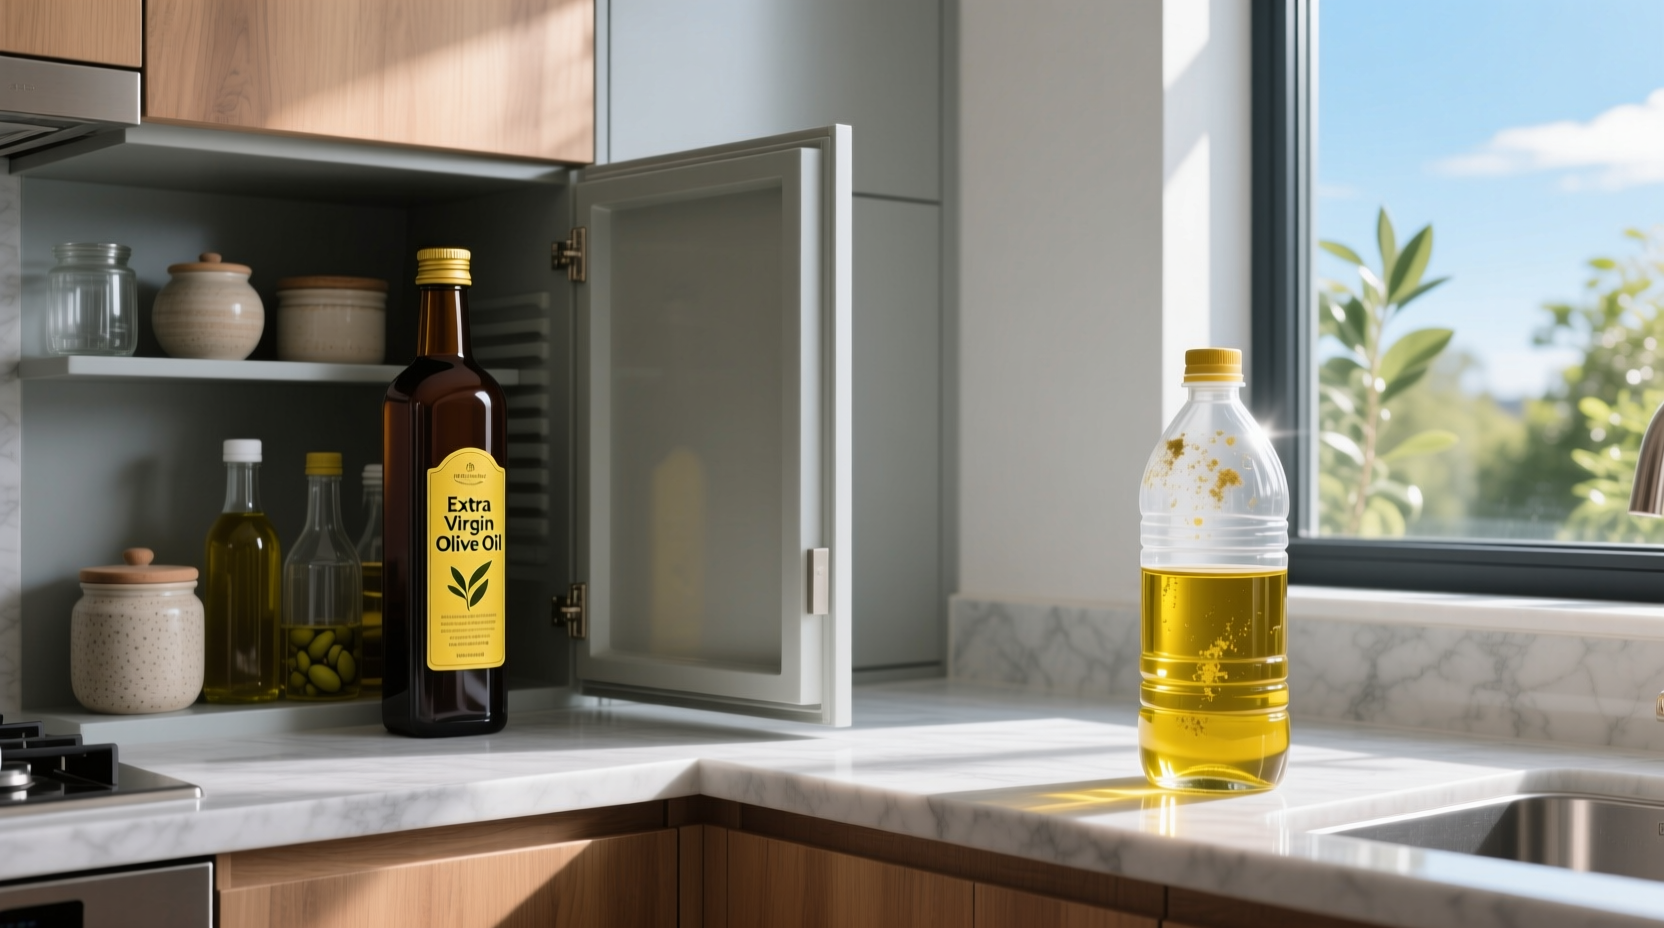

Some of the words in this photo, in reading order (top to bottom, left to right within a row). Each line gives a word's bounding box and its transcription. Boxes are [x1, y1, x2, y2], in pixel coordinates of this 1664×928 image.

[448, 496, 491, 512] Extra
[444, 516, 493, 535] Virgin
[436, 535, 478, 552] Olive
[482, 535, 501, 551] Oil
